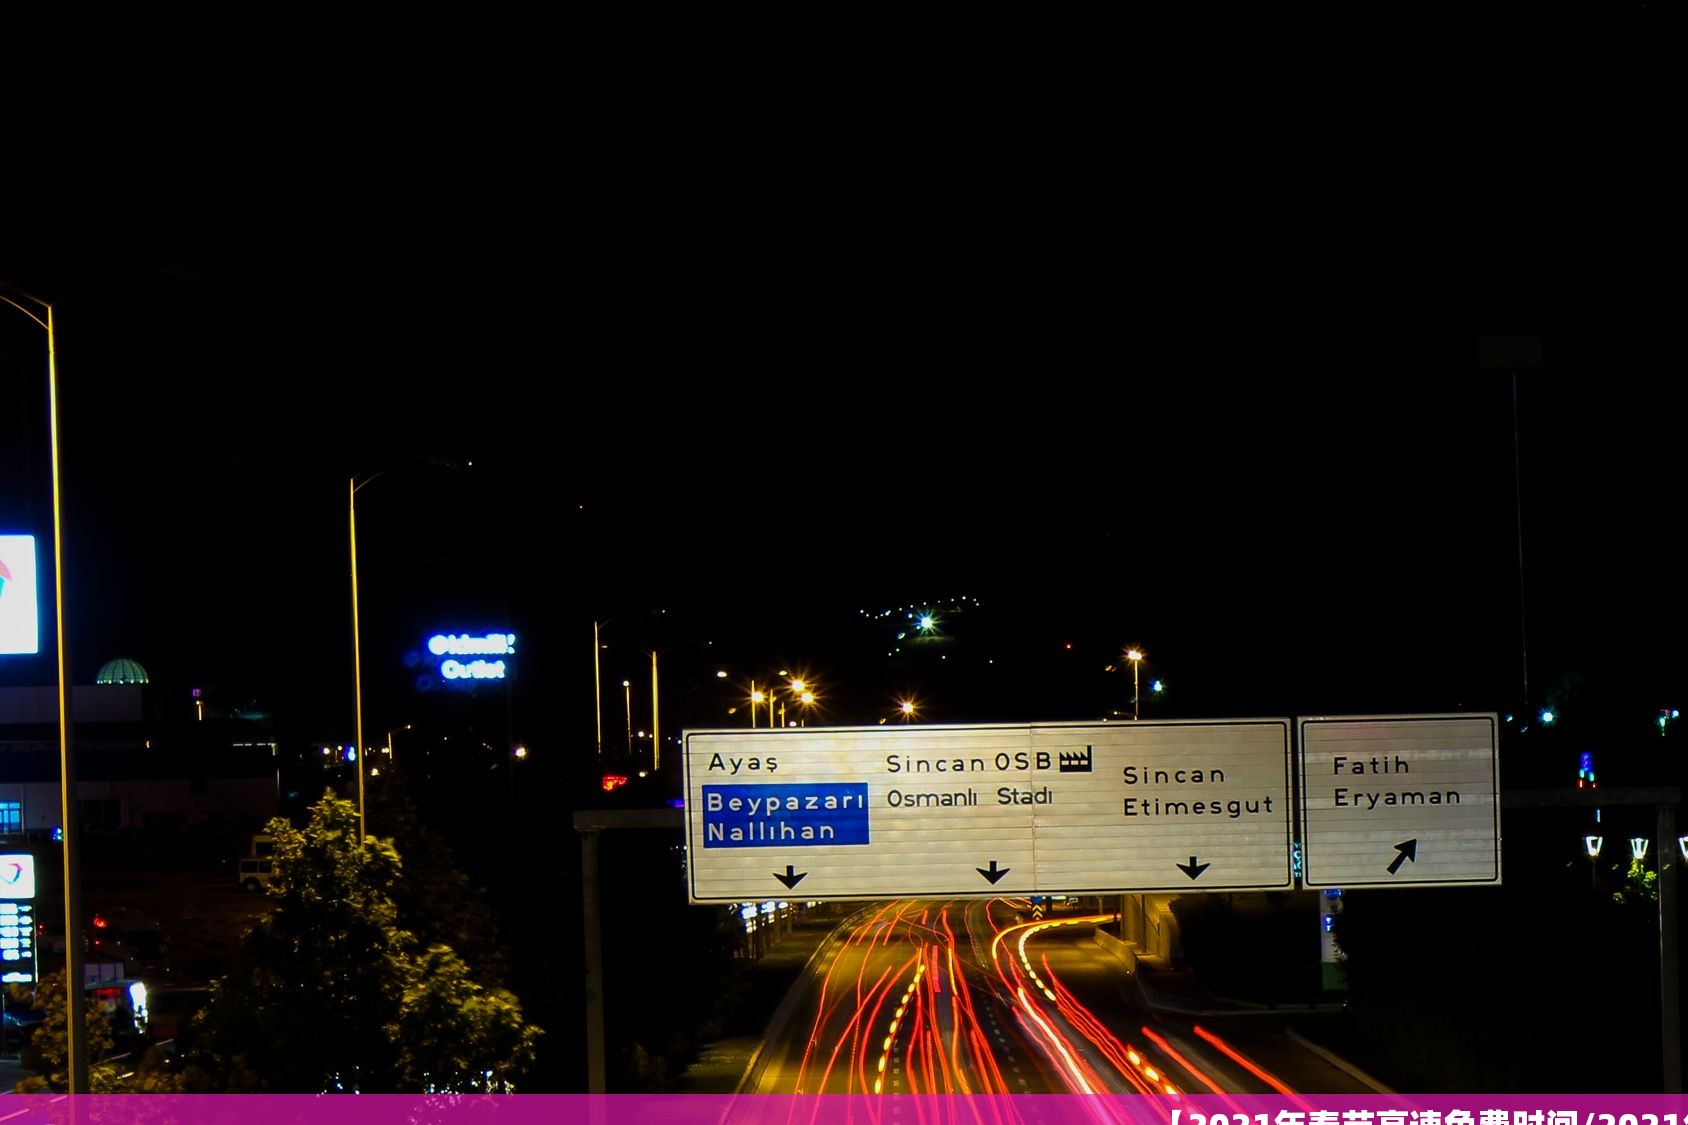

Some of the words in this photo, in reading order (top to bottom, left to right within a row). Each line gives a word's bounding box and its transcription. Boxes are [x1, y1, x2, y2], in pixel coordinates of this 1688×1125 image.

[708, 752, 778, 775] Ayaş
[886, 754, 985, 773] Sincan
[994, 751, 1052, 771] OSB
[1333, 755, 1409, 776] Fatih
[1123, 766, 1225, 785] Sincan
[707, 792, 863, 816] Beypazarı
[887, 787, 977, 808] Osmanlı
[997, 784, 1053, 805] Stadı
[1124, 795, 1273, 819] Etimesgut
[1334, 787, 1460, 811] Eryaman
[708, 821, 834, 841] Nallıhan
